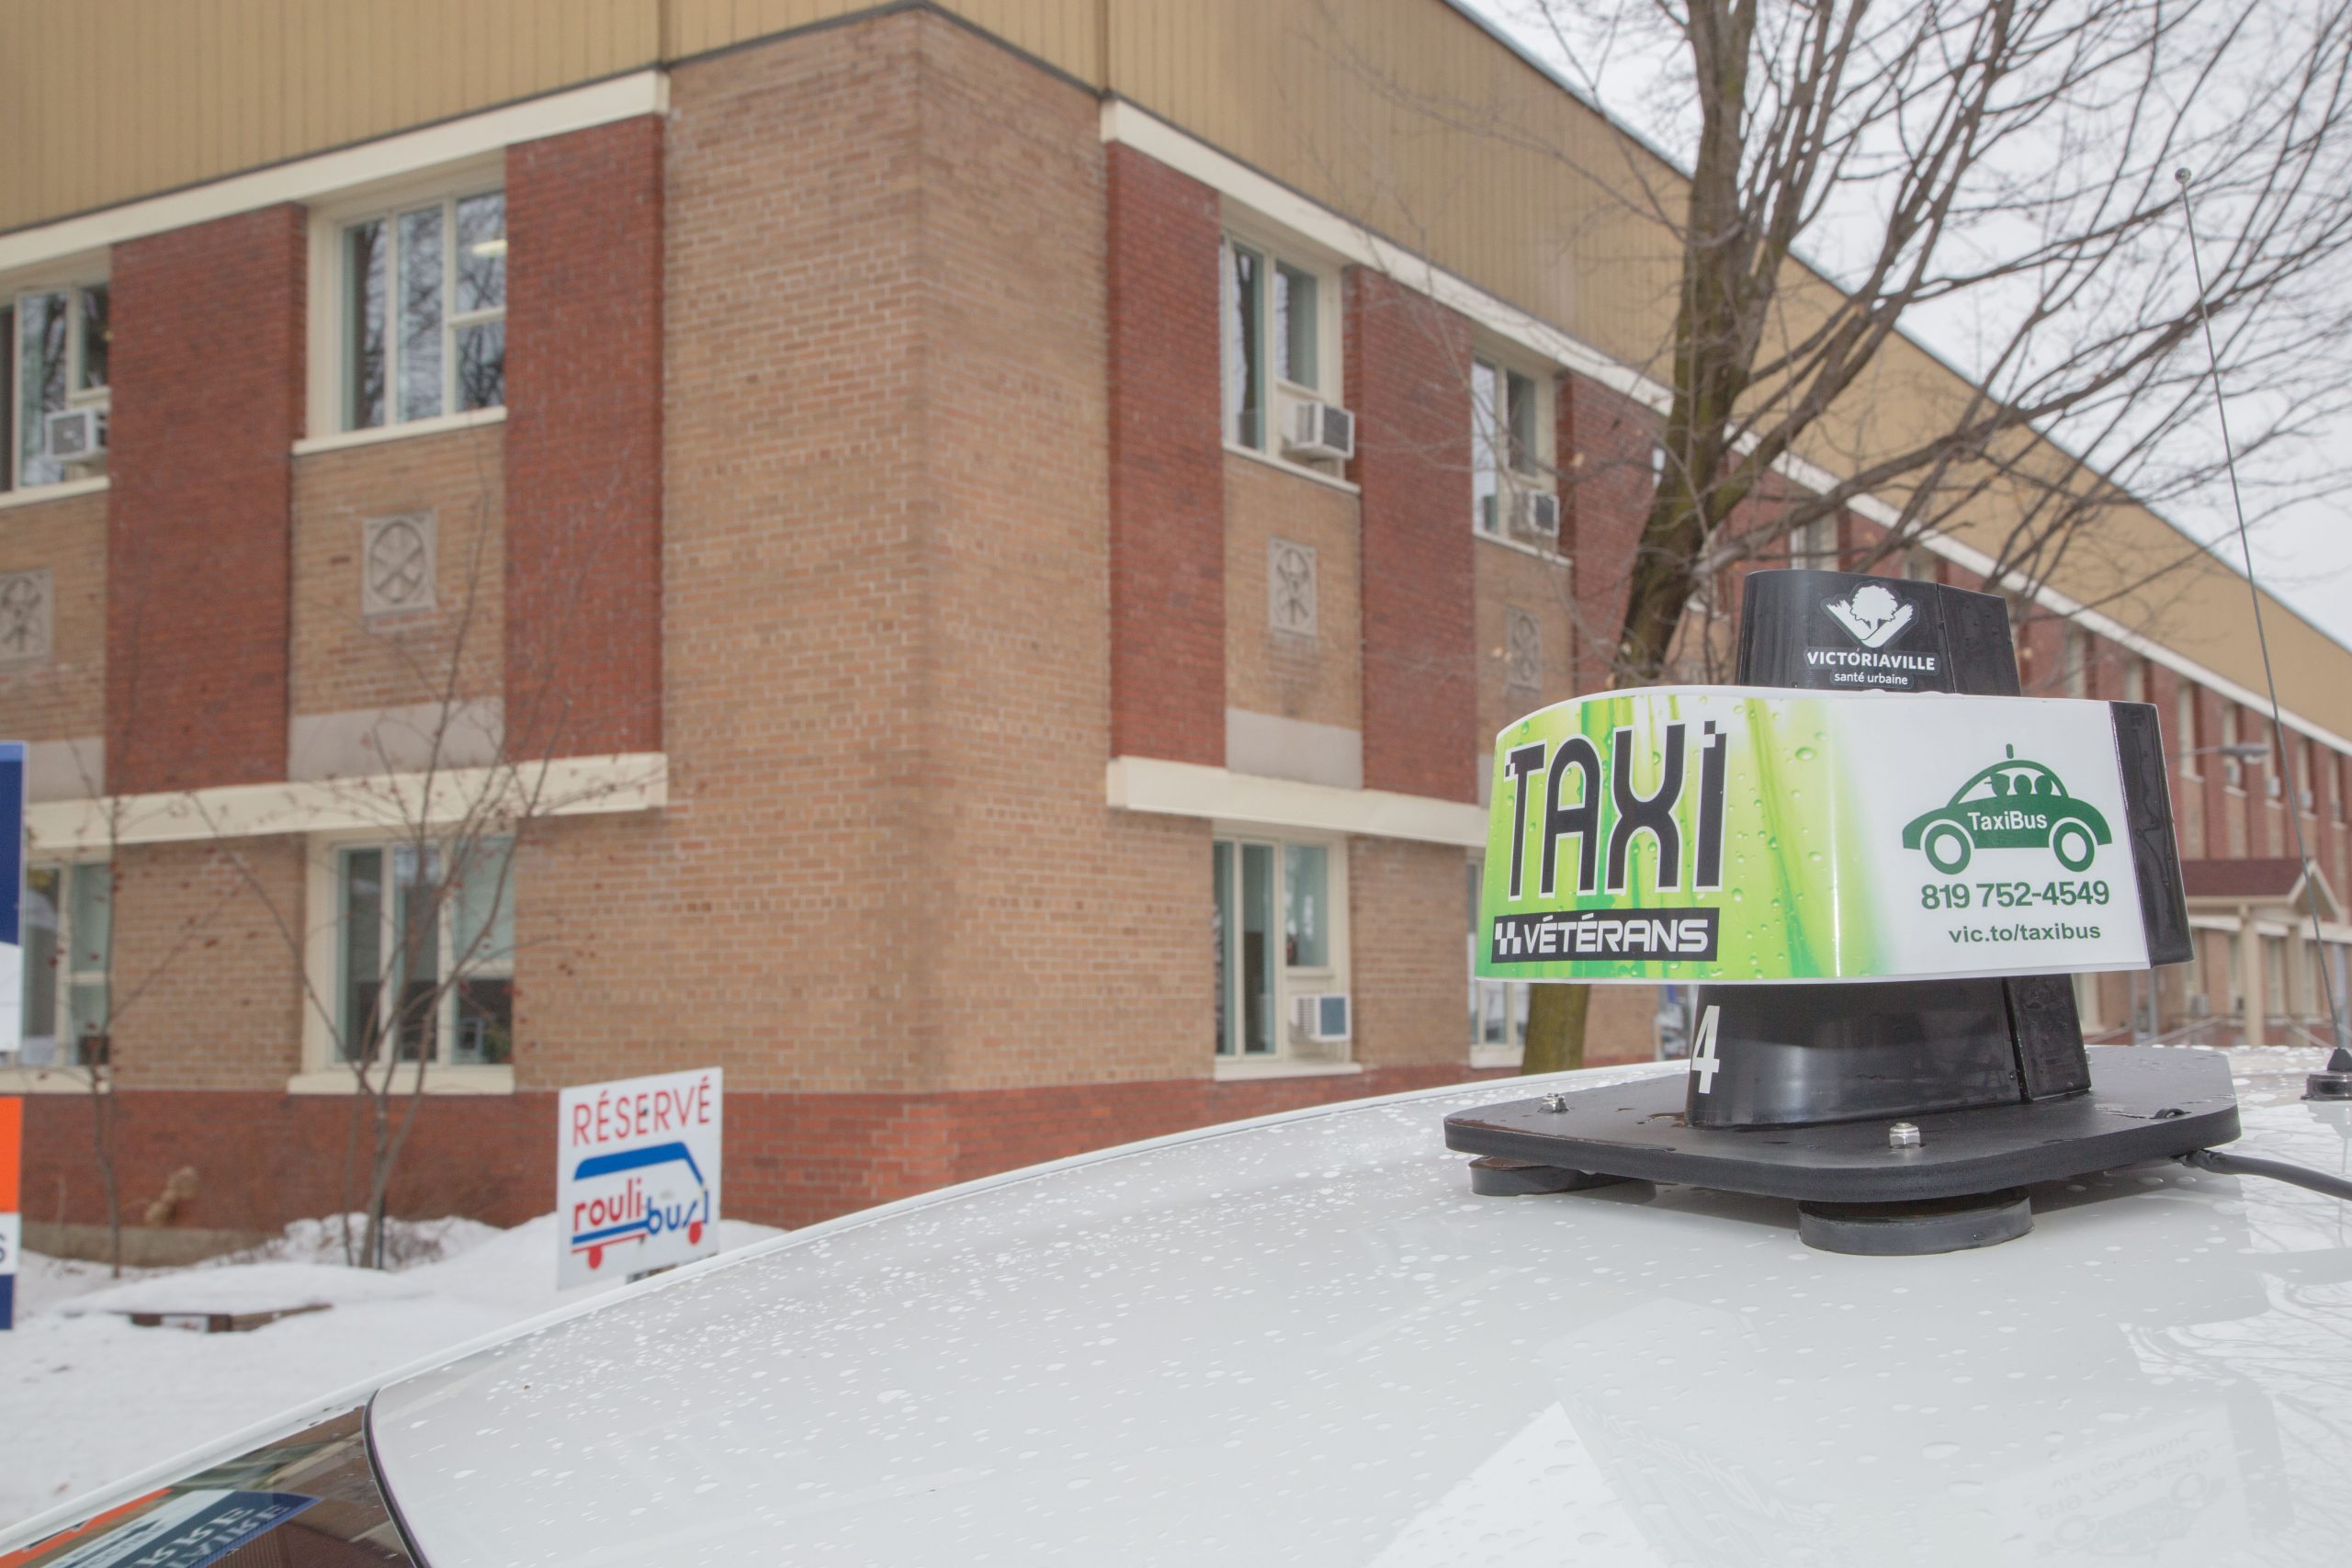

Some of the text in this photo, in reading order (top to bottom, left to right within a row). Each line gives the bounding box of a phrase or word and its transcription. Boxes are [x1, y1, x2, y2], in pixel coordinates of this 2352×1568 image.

[1807, 651, 1935, 671] VICTORIAVILLE
[1834, 671, 1908, 685] santé urbaine
[1504, 720, 1727, 901] TAXI
[1967, 810, 2048, 831] TaxiBus
[1921, 880, 2110, 909] 819 752-4549
[1523, 912, 1709, 954] VÉTÉRANS
[1948, 922, 2101, 943] vic.to/taxibus
[1690, 1005, 1721, 1094] 4
[572, 1076, 711, 1147] RÉSERVÉ
